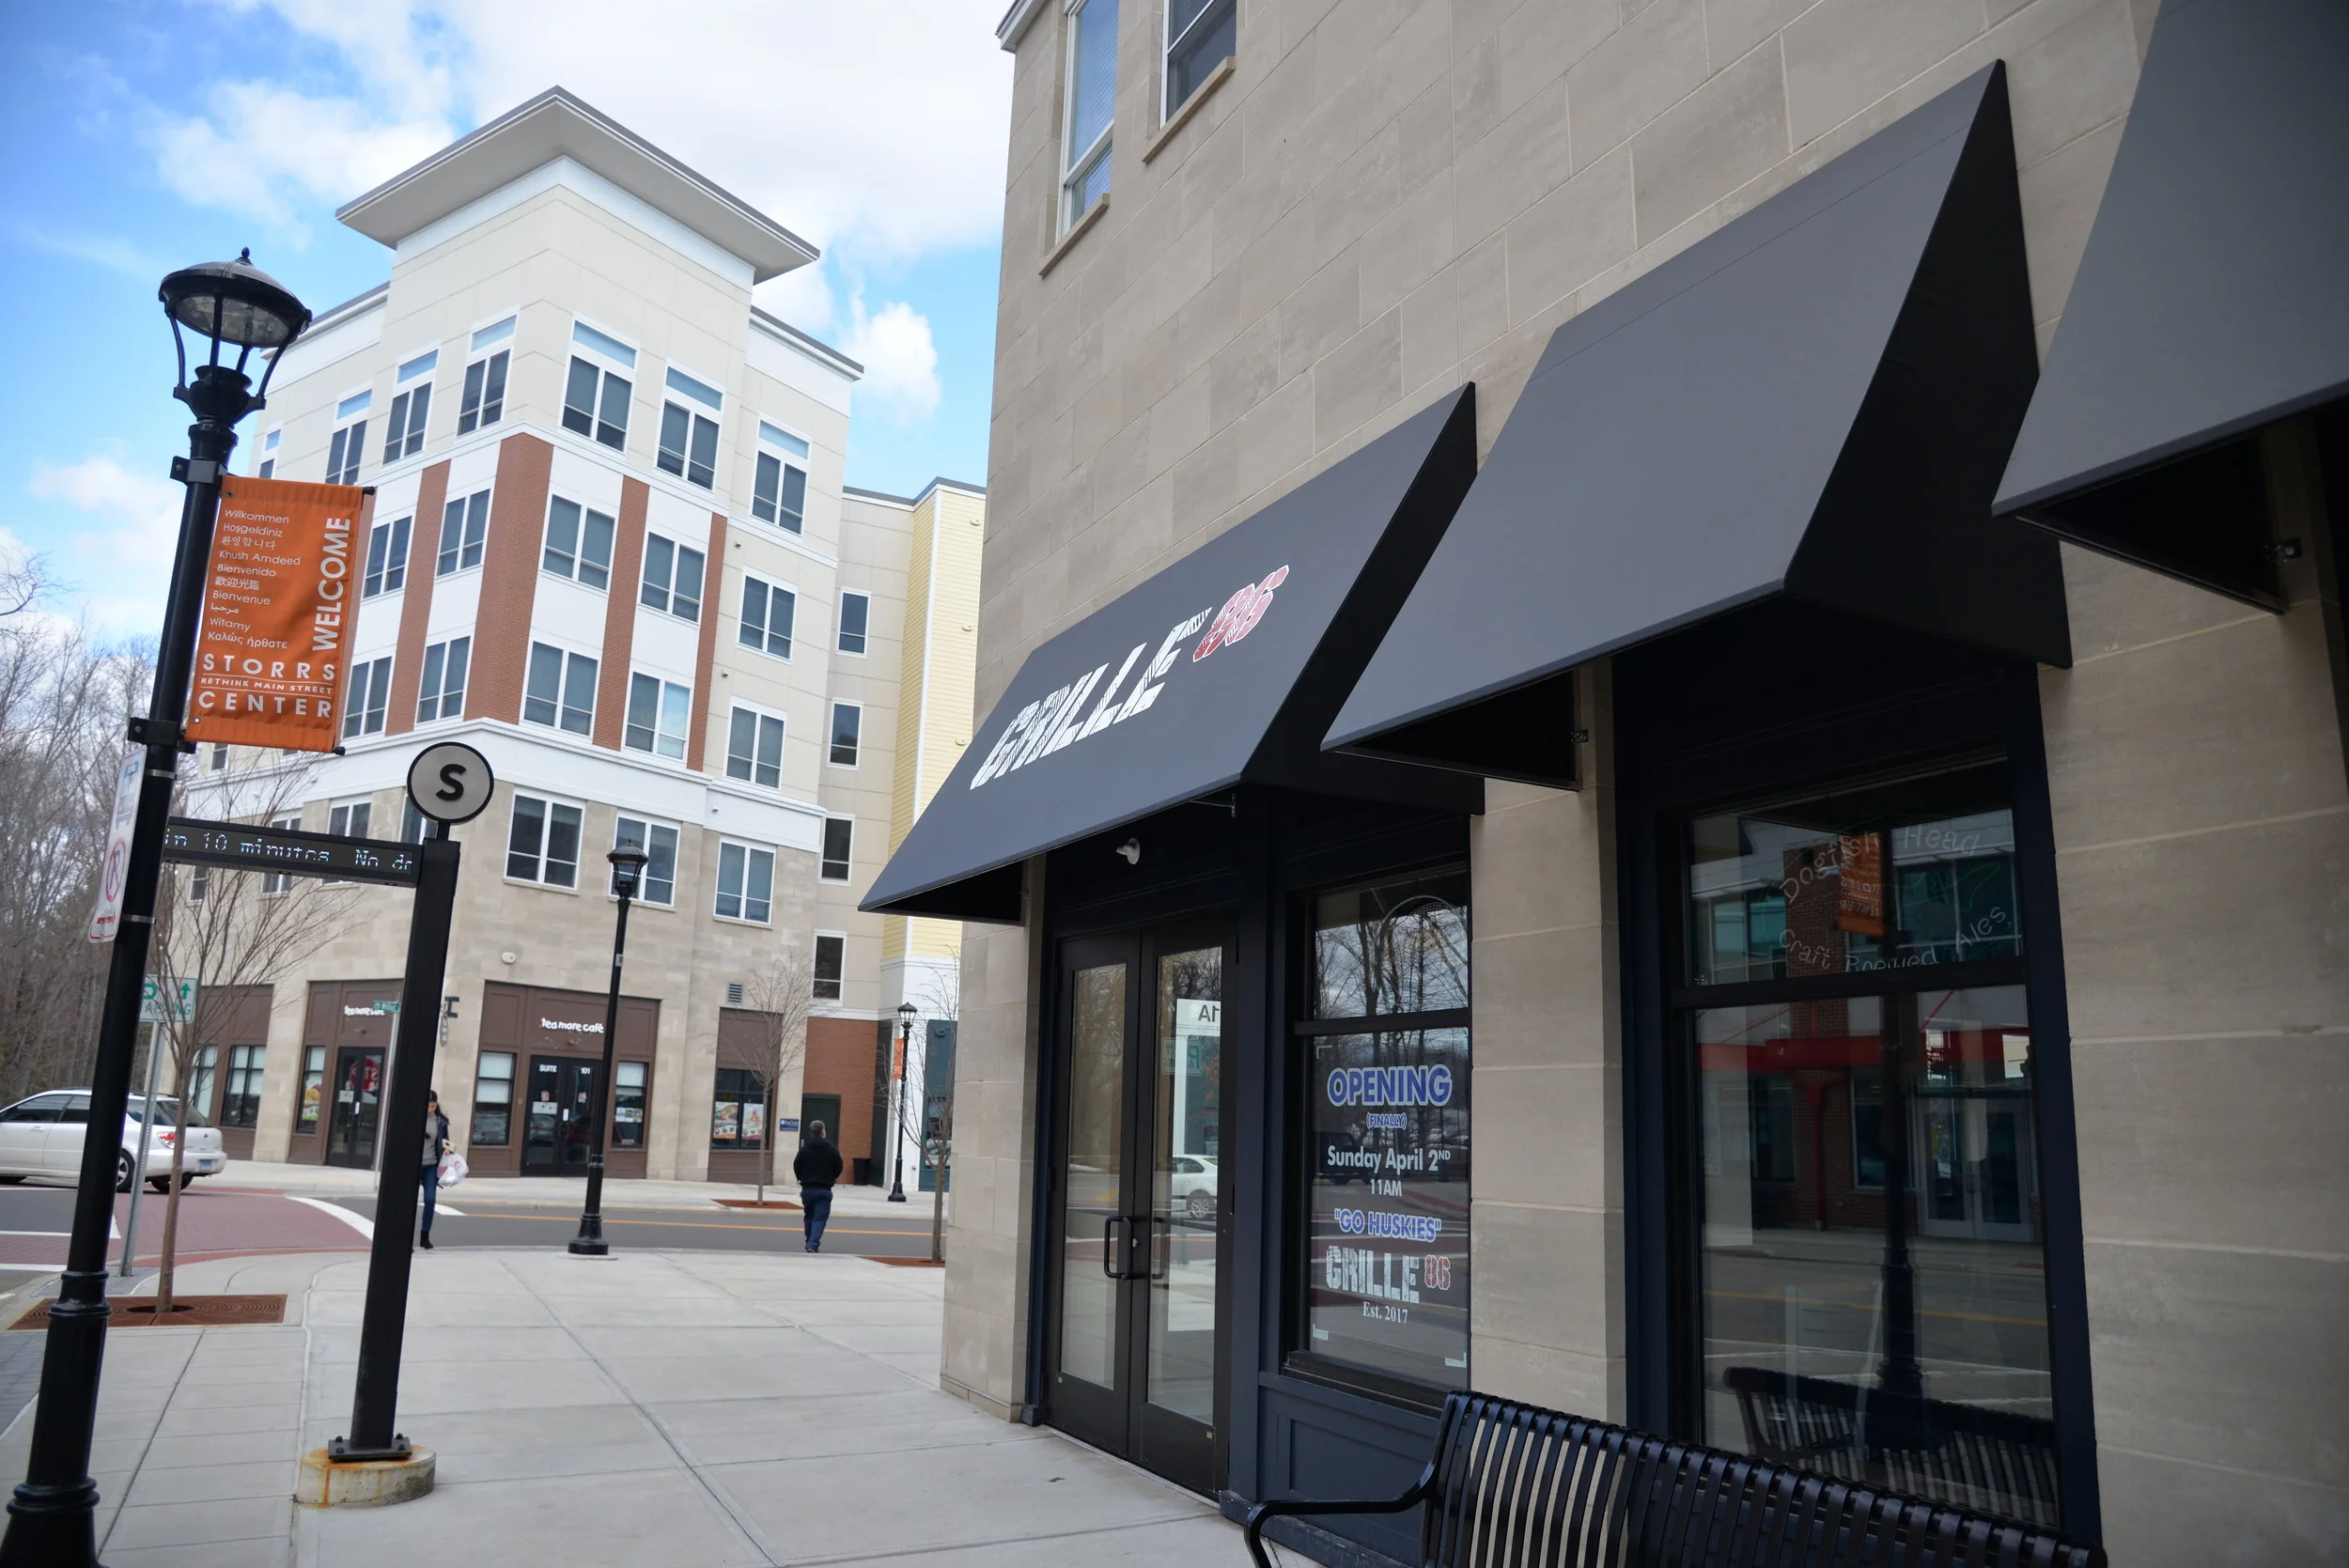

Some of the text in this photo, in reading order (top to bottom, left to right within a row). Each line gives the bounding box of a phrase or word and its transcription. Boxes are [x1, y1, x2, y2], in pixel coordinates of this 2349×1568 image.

[225, 509, 289, 524] Willkommen
[223, 522, 284, 537] Hoşgeldiniz
[222, 536, 276, 550] 환영합니다
[219, 550, 301, 566] Khush Amdeed
[217, 564, 276, 577] Bienvenido
[312, 518, 350, 651] WELCOME
[212, 590, 271, 605] Bienvenue
[210, 603, 240, 614] مرحبا
[210, 617, 251, 632] Witamy
[202, 653, 335, 681] STORRS
[200, 677, 334, 694] RETHINK MAIN STREET
[970, 564, 1289, 790] GRILLE 86
[198, 691, 332, 718] CENTER
[435, 763, 467, 801] S
[203, 831, 228, 850] 10
[1905, 826, 1982, 857] Head
[540, 1017, 558, 1029] tea
[558, 1021, 582, 1032] more
[539, 1064, 557, 1073] SUITE
[1327, 1063, 1453, 1107] OPENING
[1365, 1111, 1408, 1130] (FINALLY)
[1327, 1144, 1451, 1175] Sunday April 2ND
[1370, 1178, 1403, 1197] 11AM
[1334, 1207, 1442, 1243] "GO HUSKIES"
[1326, 1245, 1451, 1304] GRILLE 86
[1363, 1301, 1408, 1325] Est. 2017
